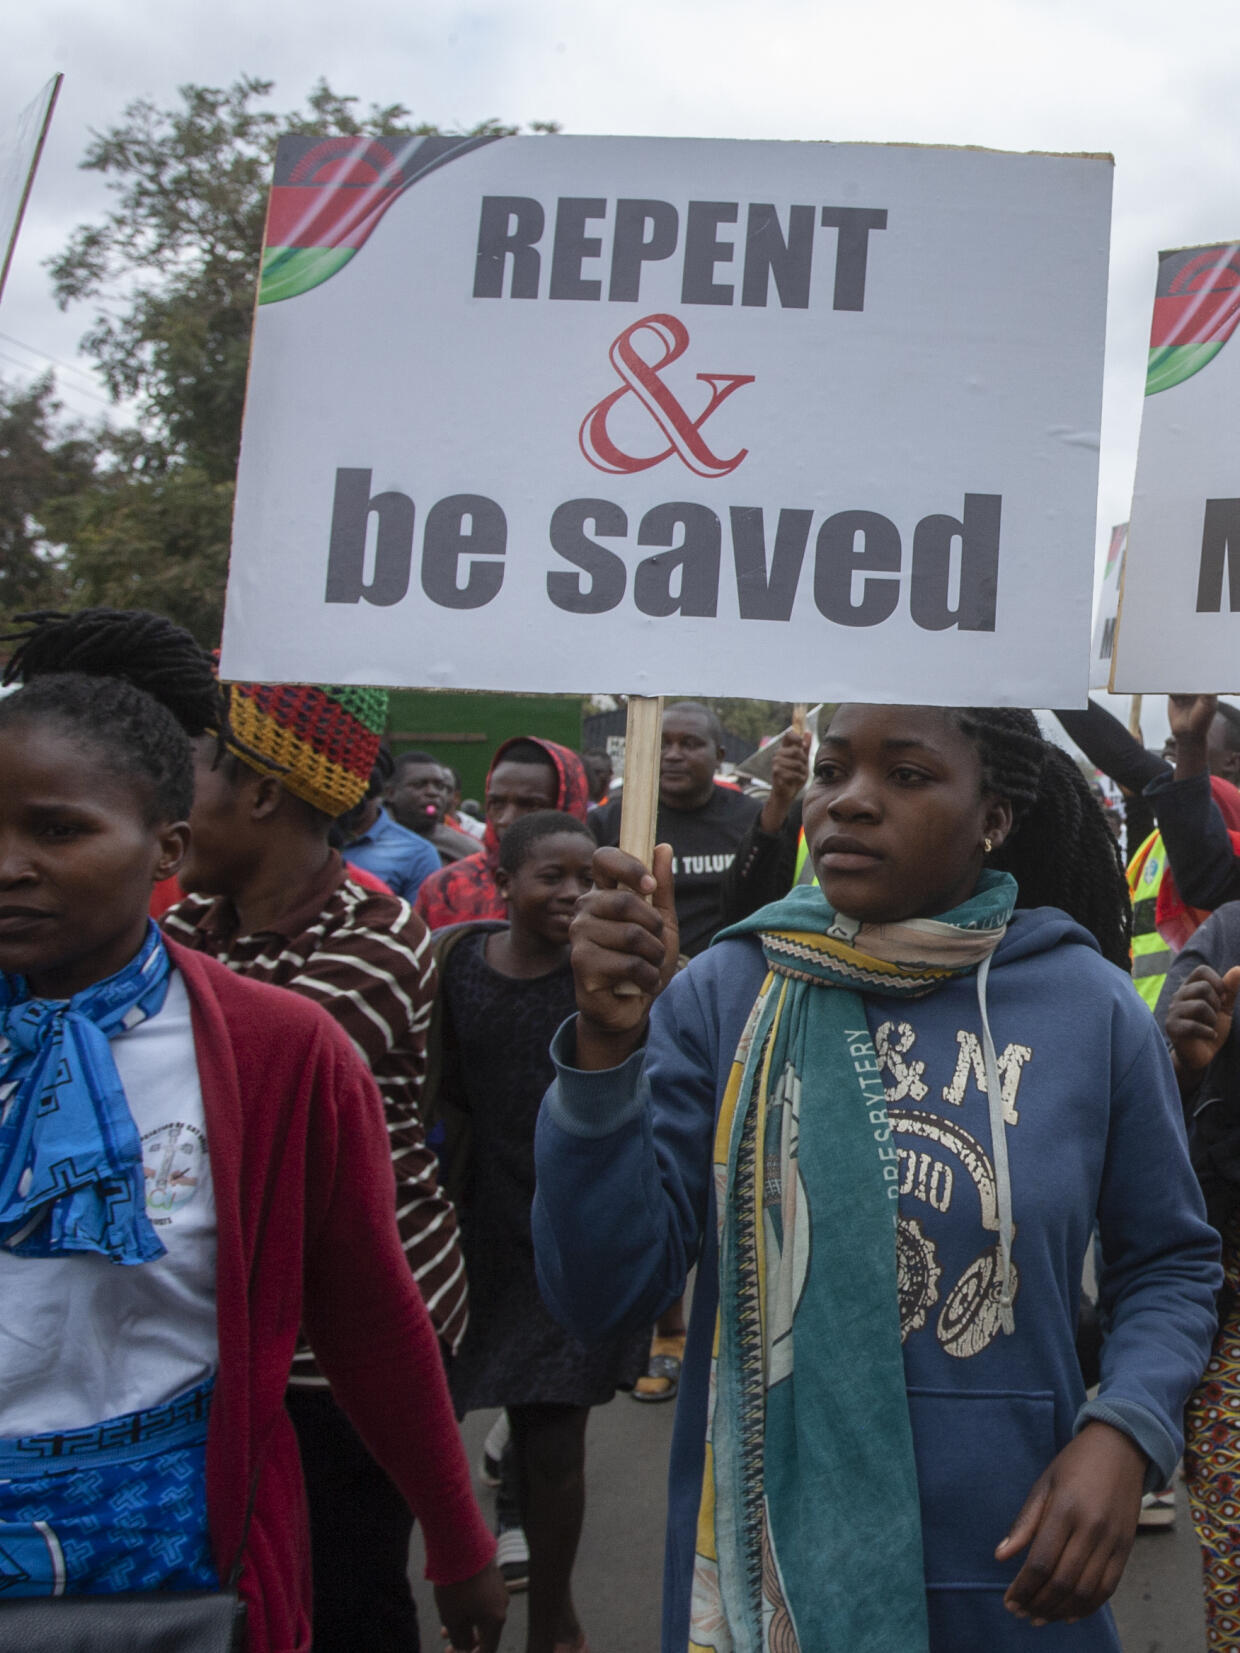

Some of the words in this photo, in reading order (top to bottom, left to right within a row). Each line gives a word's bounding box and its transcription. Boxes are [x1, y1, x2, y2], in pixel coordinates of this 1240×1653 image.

[473, 196, 888, 311] REPENT
[579, 314, 755, 478] &
[325, 468, 507, 609] be
[547, 493, 1002, 632] saved
